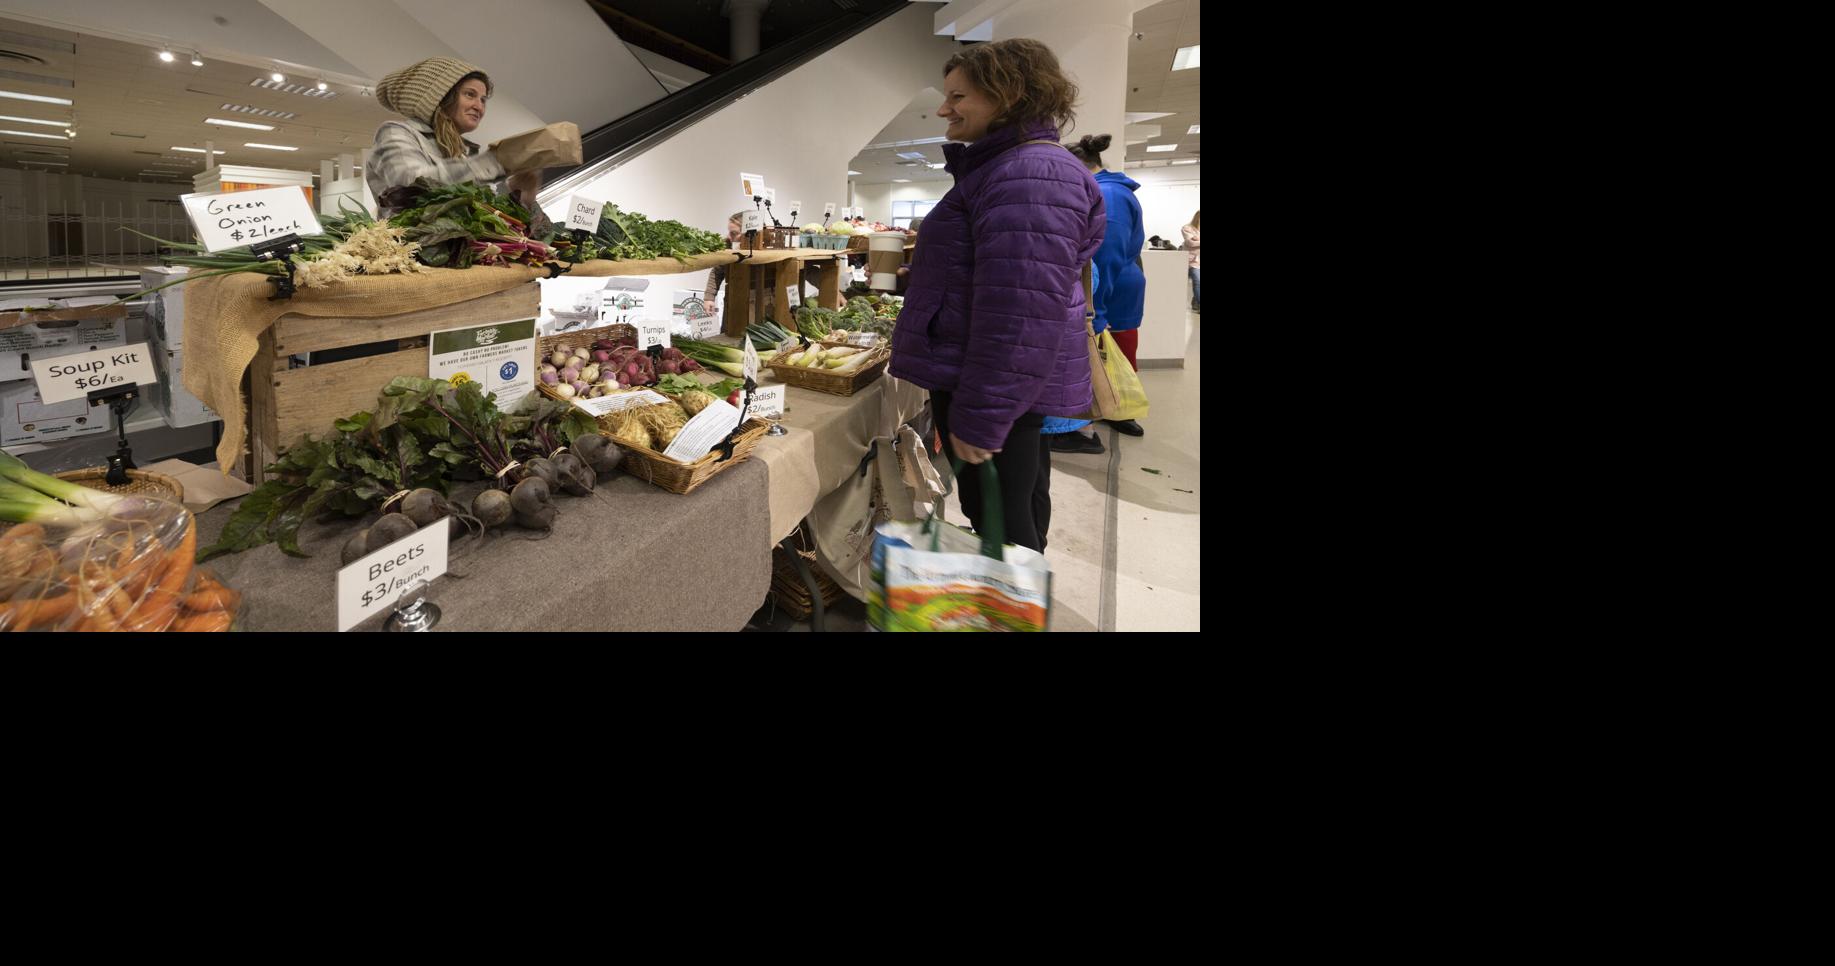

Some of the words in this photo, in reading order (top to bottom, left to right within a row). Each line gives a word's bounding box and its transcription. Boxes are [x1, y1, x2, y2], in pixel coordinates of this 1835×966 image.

[207, 199, 266, 215] Green
[577, 203, 596, 216] Chard
[219, 214, 272, 229] Onion
[642, 326, 666, 335] Turnips
[49, 360, 105, 378] Soup
[111, 352, 139, 366] Kit
[75, 373, 124, 390] $6/Ea
[750, 391, 776, 403] Radish
[369, 543, 425, 581] Beets
[361, 565, 430, 608] $3/Bunch
